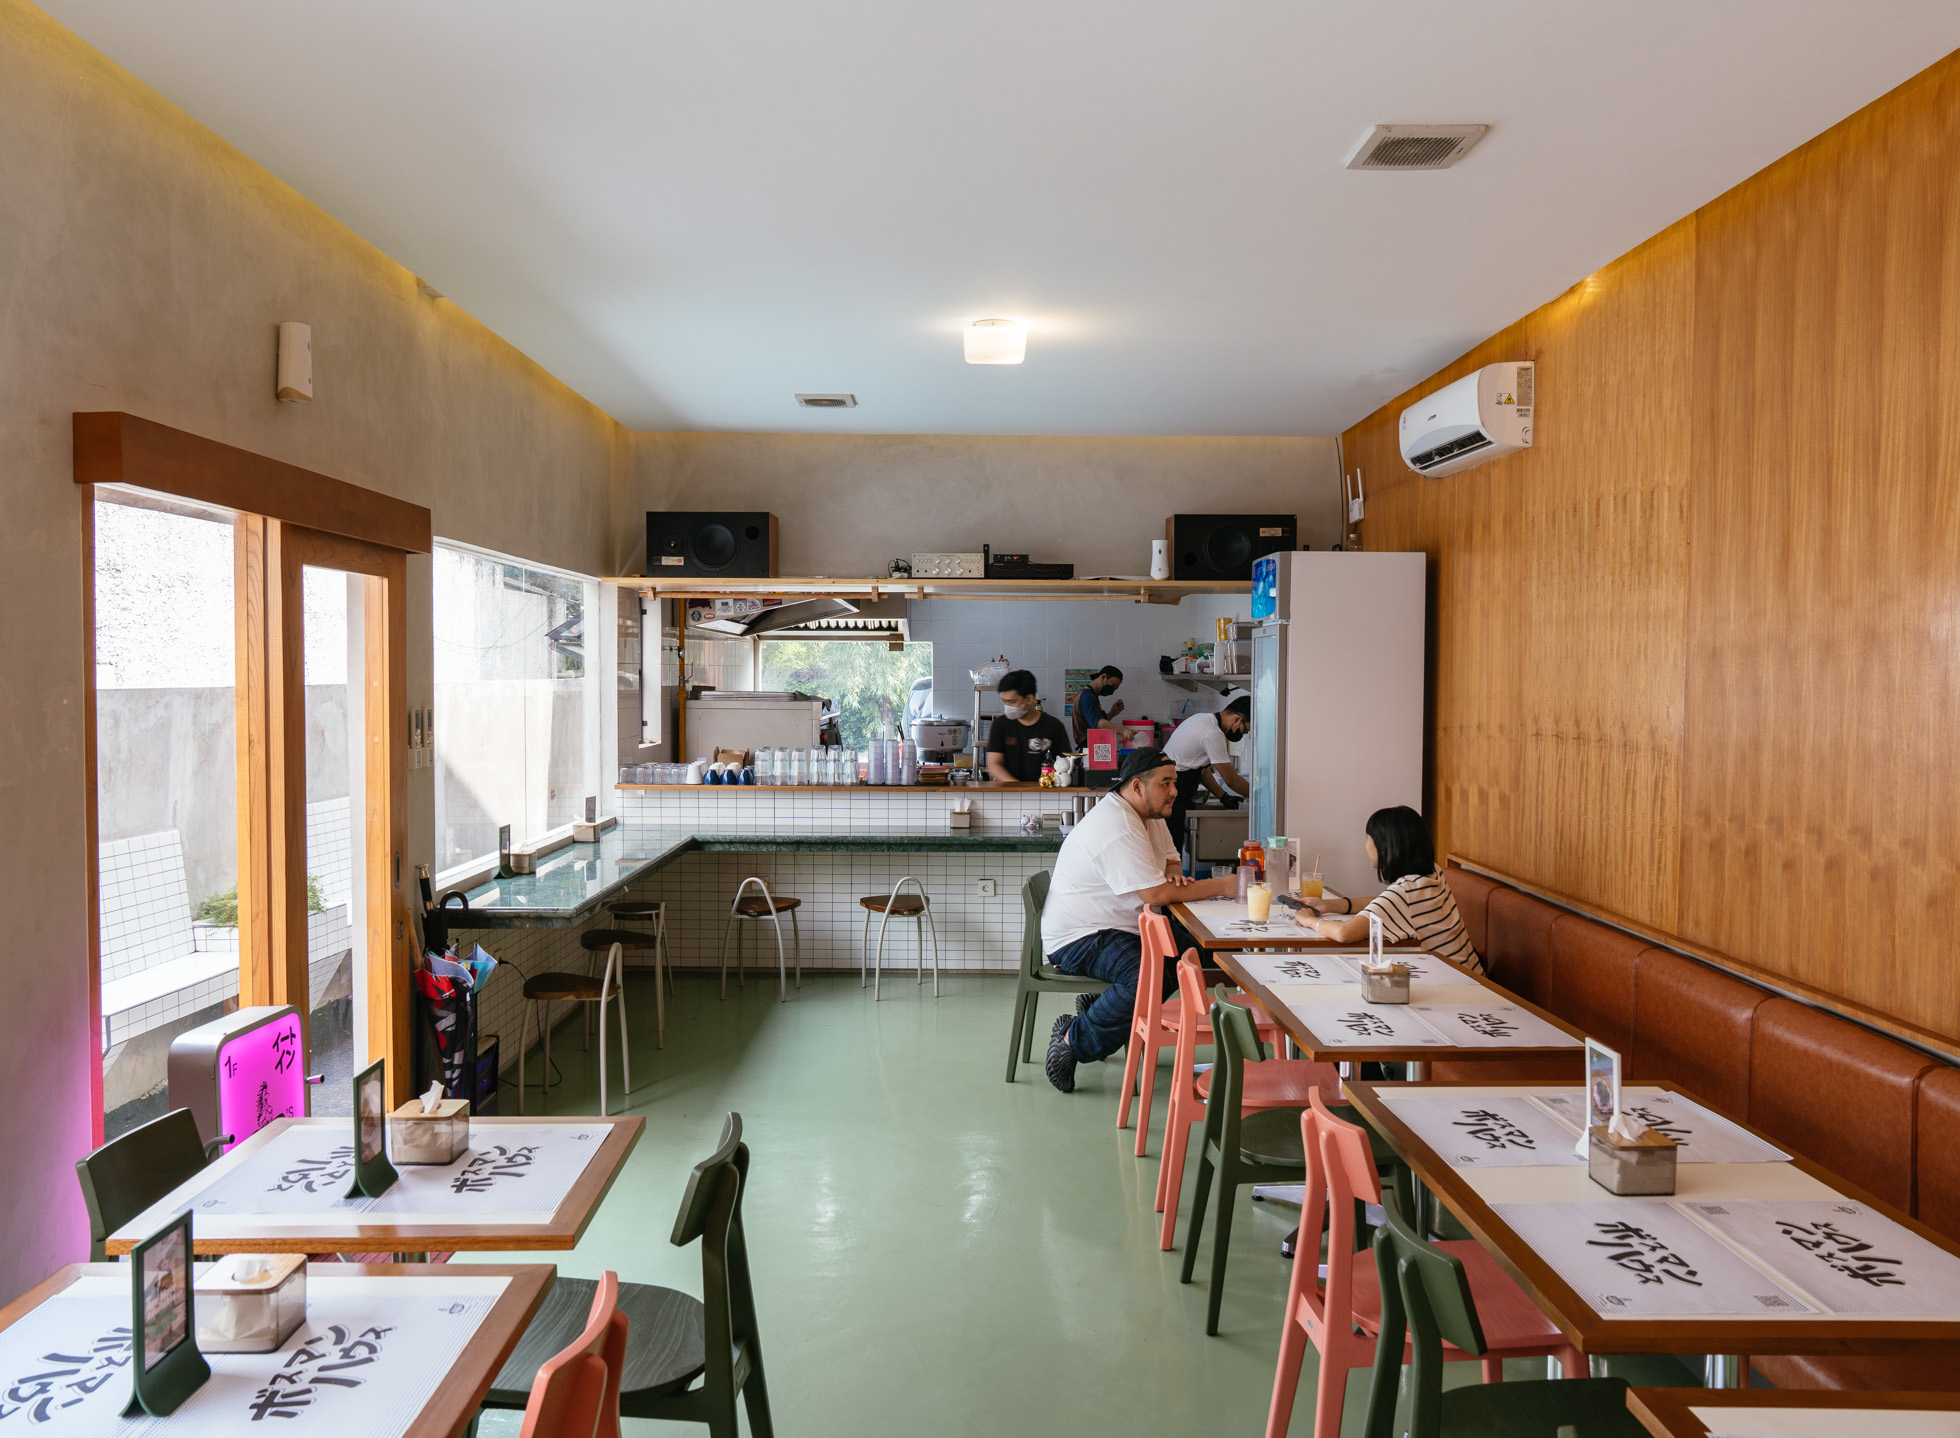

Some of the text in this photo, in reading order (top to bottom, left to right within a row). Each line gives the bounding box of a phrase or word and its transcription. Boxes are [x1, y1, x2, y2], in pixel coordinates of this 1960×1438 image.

[272, 1025, 296, 1053] イート
[224, 1055, 238, 1079] 1F
[274, 1049, 296, 1075] イン
[1451, 1121, 1507, 1149] ハウス
[1460, 1109, 1537, 1150] ボスマン
[450, 1145, 509, 1194] ボスマン
[487, 1145, 542, 1178] ハウス
[1585, 1240, 1665, 1285] ハウス
[1593, 1221, 1703, 1287] ボスマン
[1775, 1220, 1907, 1288] ボスマン
[1809, 1221, 1904, 1265] ハウス
[248, 1324, 350, 1422] ボスマン
[307, 1325, 398, 1389] ハウス
